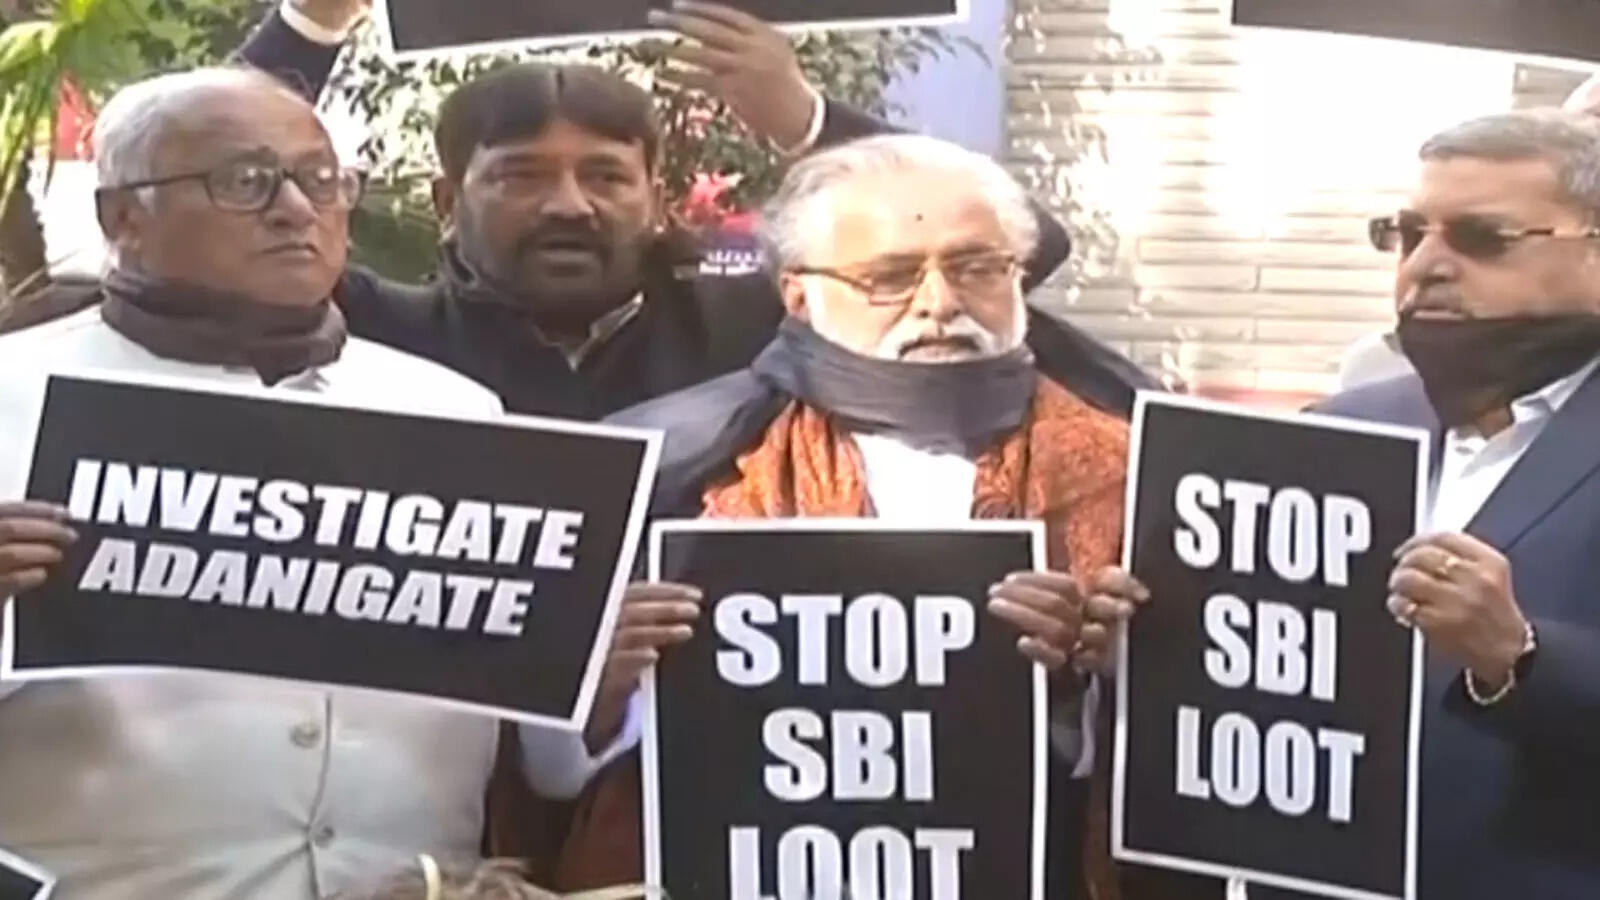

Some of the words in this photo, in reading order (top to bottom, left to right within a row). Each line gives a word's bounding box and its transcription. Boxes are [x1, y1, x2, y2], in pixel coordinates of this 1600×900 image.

[68, 458, 584, 570] INVESTIGATE
[1173, 473, 1371, 587] STOP
[78, 537, 534, 636] ADANIGATE
[714, 593, 975, 687] STOP
[1204, 594, 1338, 702] SBI
[762, 708, 934, 801] SBI
[1175, 705, 1366, 822] LOOT
[728, 825, 974, 900] LOOT
